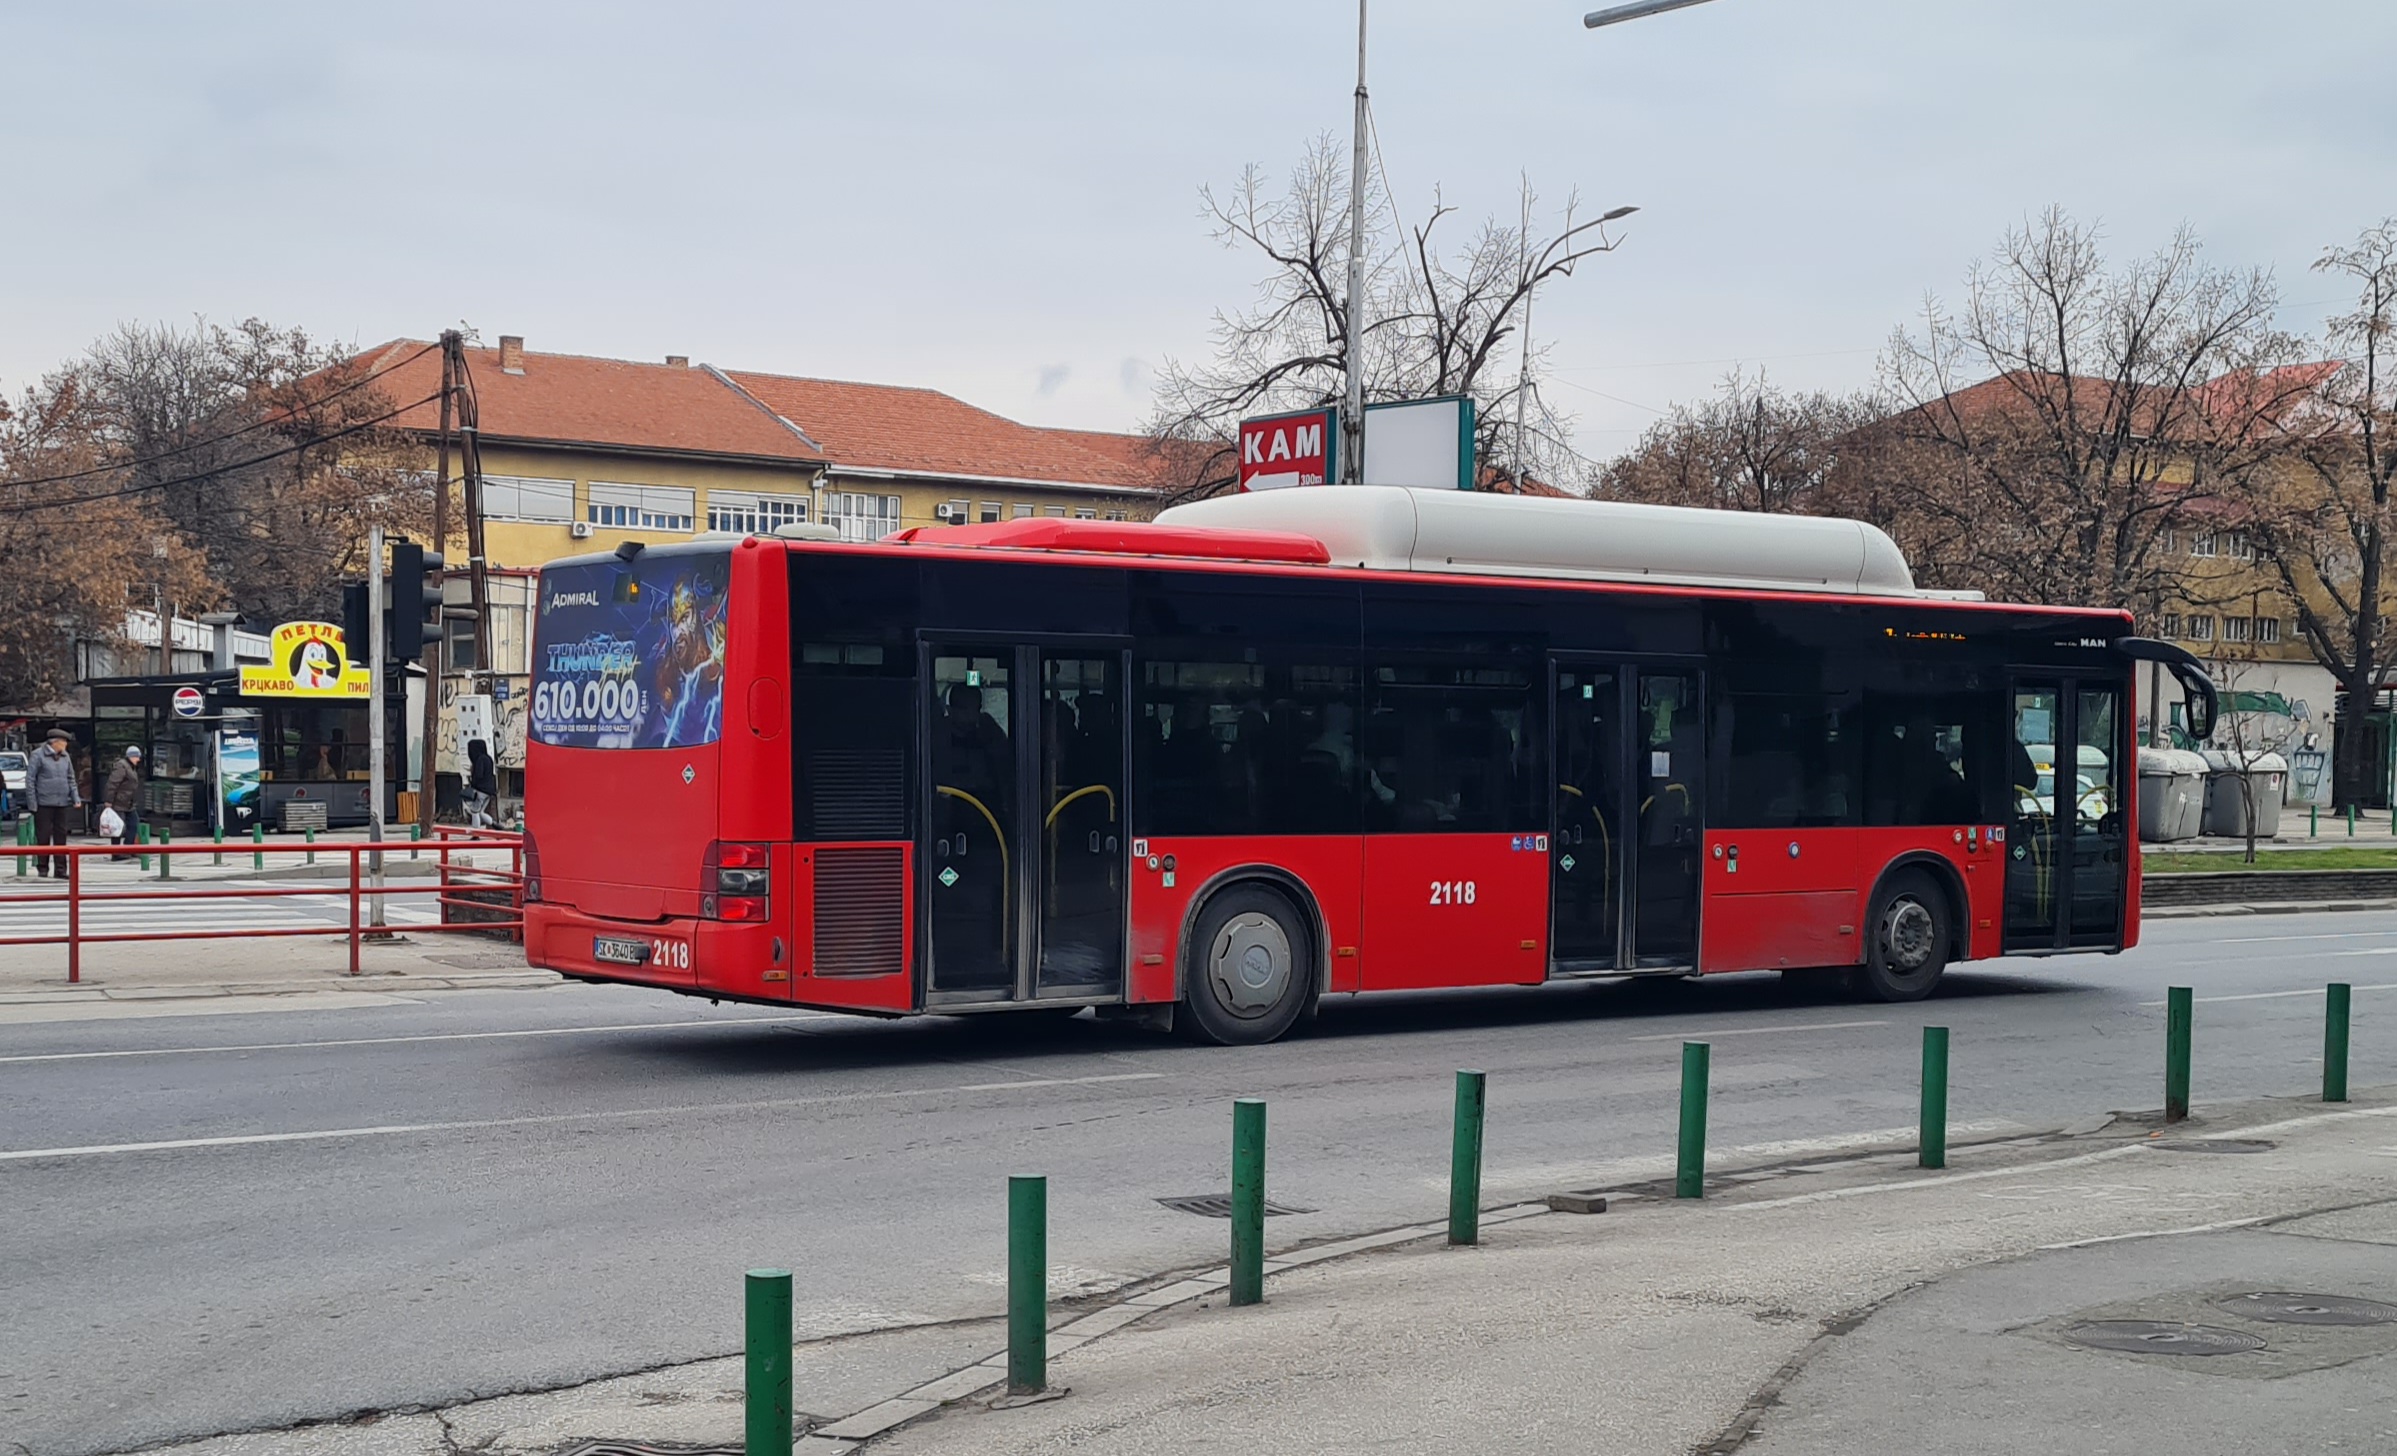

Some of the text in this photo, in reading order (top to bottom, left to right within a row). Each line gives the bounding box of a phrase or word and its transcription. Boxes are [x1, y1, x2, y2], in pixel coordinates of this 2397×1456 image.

[1301, 473, 1323, 486] 300m
[551, 590, 600, 609] ADMIRAL
[2080, 638, 2106, 648] MAN
[242, 680, 369, 693] КРЦКАВО ПИЛ
[534, 679, 639, 719] 610.000
[1430, 881, 1476, 905] 2118
[653, 939, 689, 969] 2118
